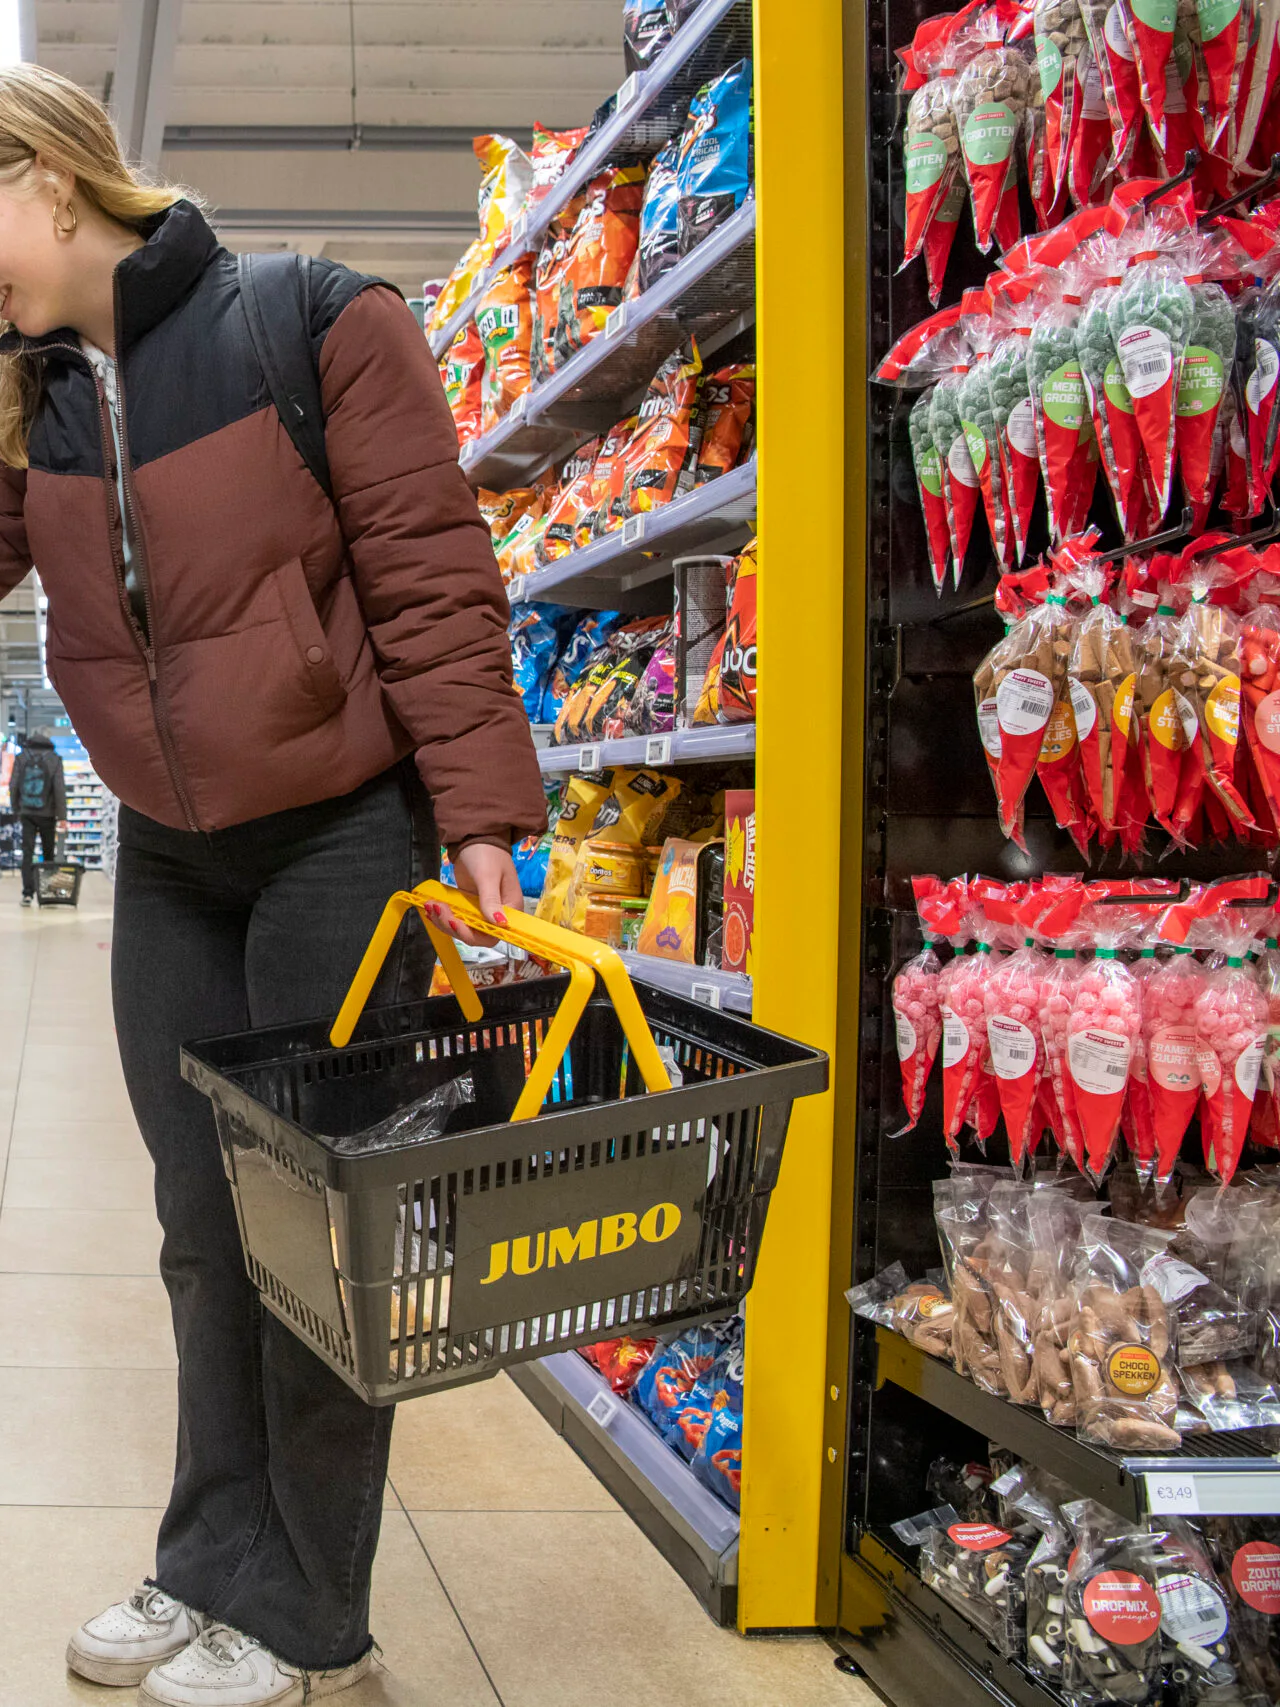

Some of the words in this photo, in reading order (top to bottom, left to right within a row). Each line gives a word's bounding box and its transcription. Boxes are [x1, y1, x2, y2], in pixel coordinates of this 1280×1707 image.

[693, 145, 720, 157] RICAN
[590, 868, 613, 877] Doritos
[480, 1202, 681, 1285] JUMBO
[1119, 1361, 1150, 1371] CHOCO
[1113, 1370, 1155, 1381] SPEKKEN
[1157, 1486, 1193, 1501] €3,49
[1091, 1599, 1149, 1613] DROPMIX
[1112, 1612, 1150, 1624] gemengd
